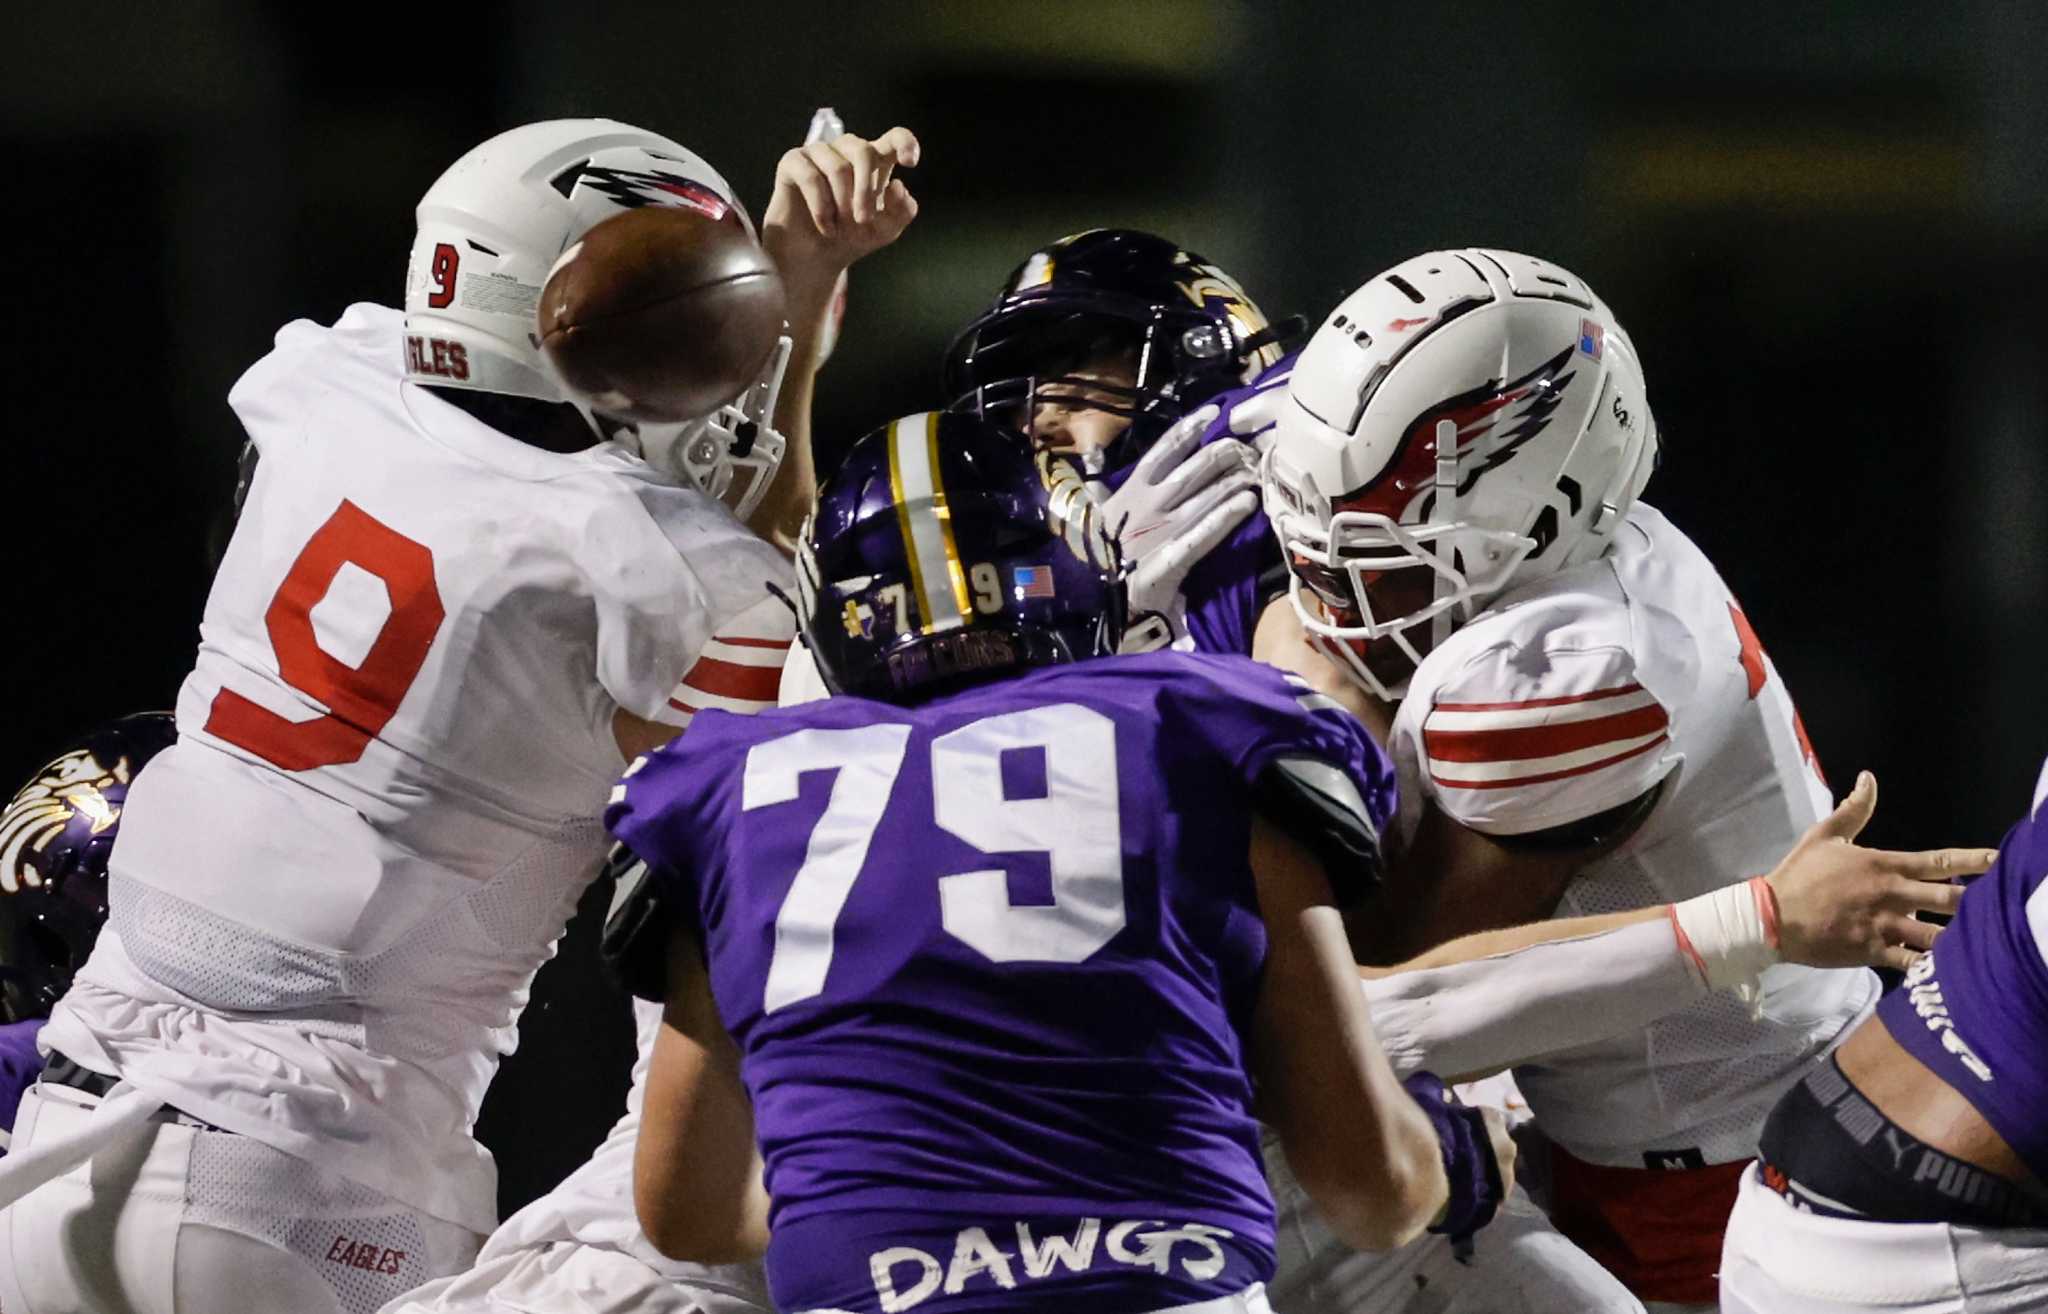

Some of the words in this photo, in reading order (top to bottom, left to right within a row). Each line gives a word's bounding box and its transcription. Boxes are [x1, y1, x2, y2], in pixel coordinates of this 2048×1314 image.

[428, 242, 460, 309] 9
[202, 497, 446, 773] 9
[742, 702, 1127, 1016] 79
[325, 1235, 406, 1275] EAGLES
[868, 1217, 1233, 1313] DAWGS
